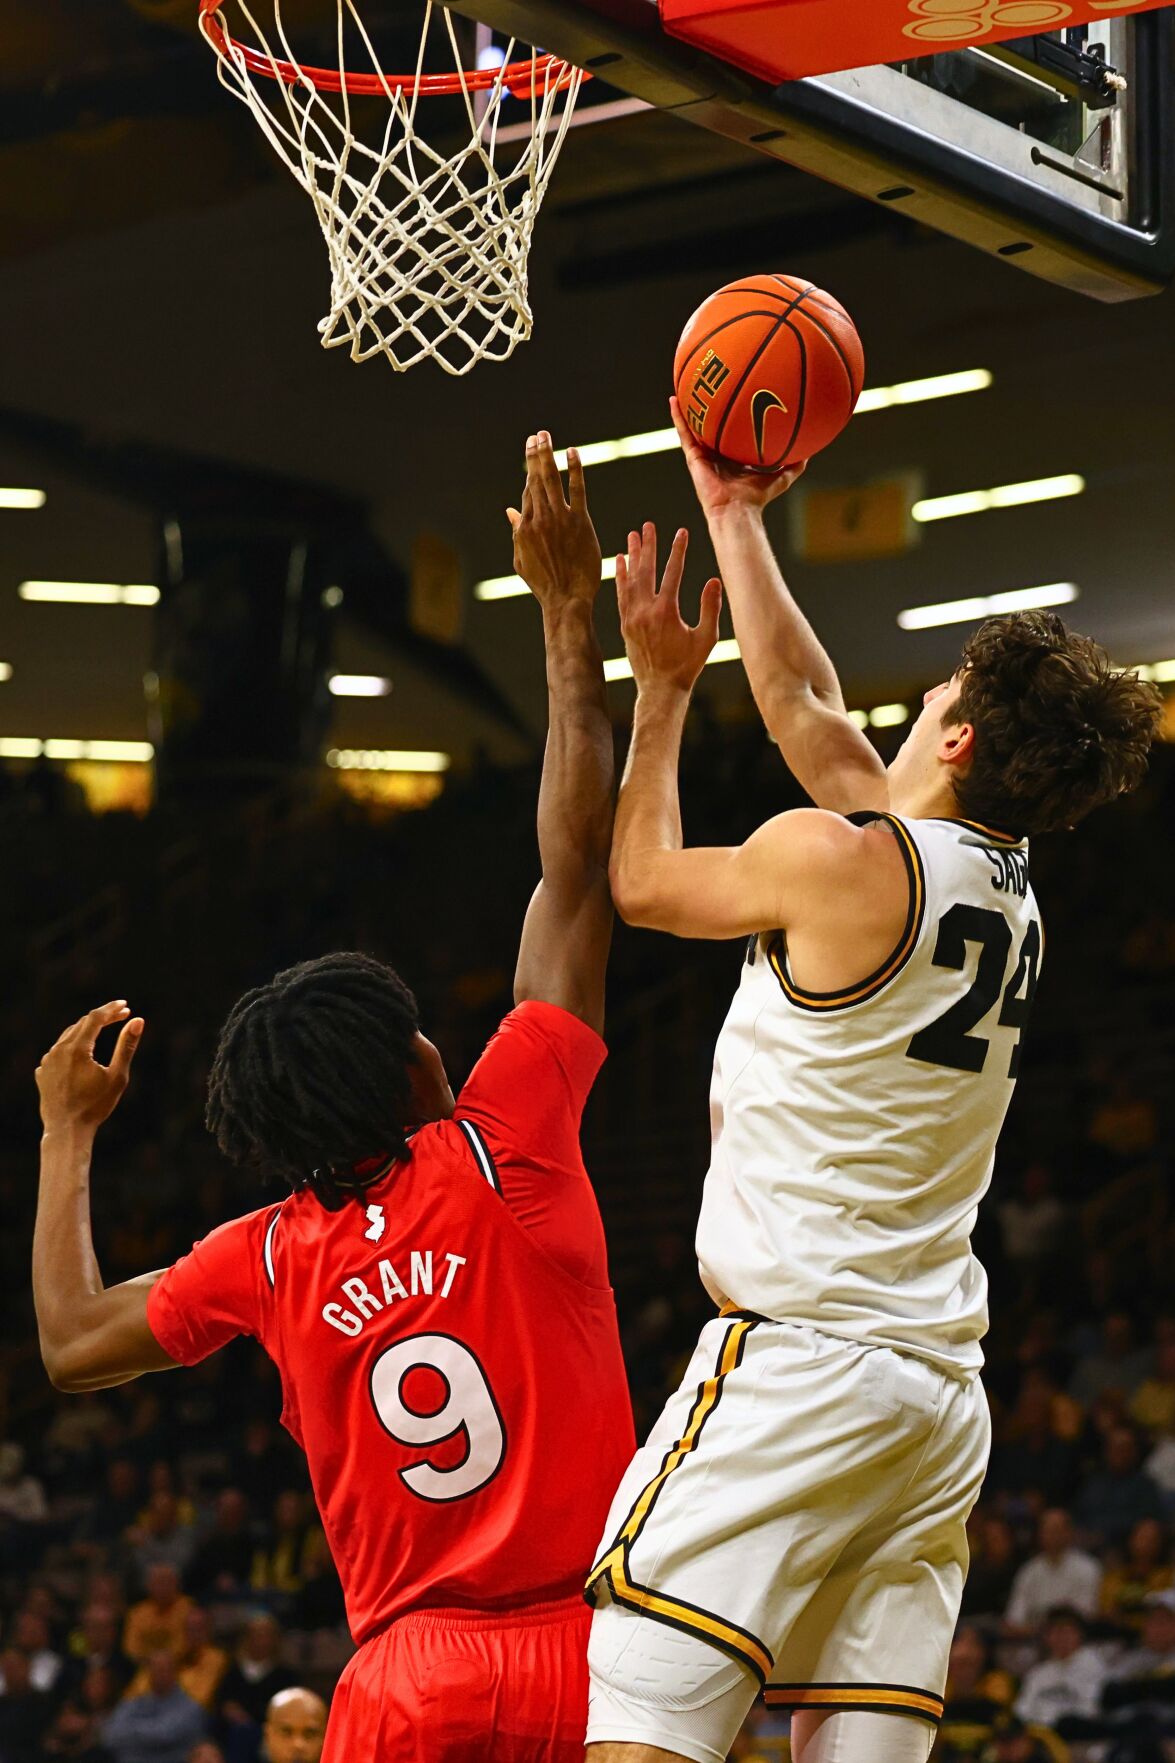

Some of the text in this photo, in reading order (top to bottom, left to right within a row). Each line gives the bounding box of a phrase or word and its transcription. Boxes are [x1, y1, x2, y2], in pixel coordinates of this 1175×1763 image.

[688, 355, 732, 437] ELITE
[986, 848, 1028, 899] SAG
[907, 902, 1040, 1079] 24
[322, 1251, 467, 1337] GRANT
[371, 1332, 507, 1503] 9
